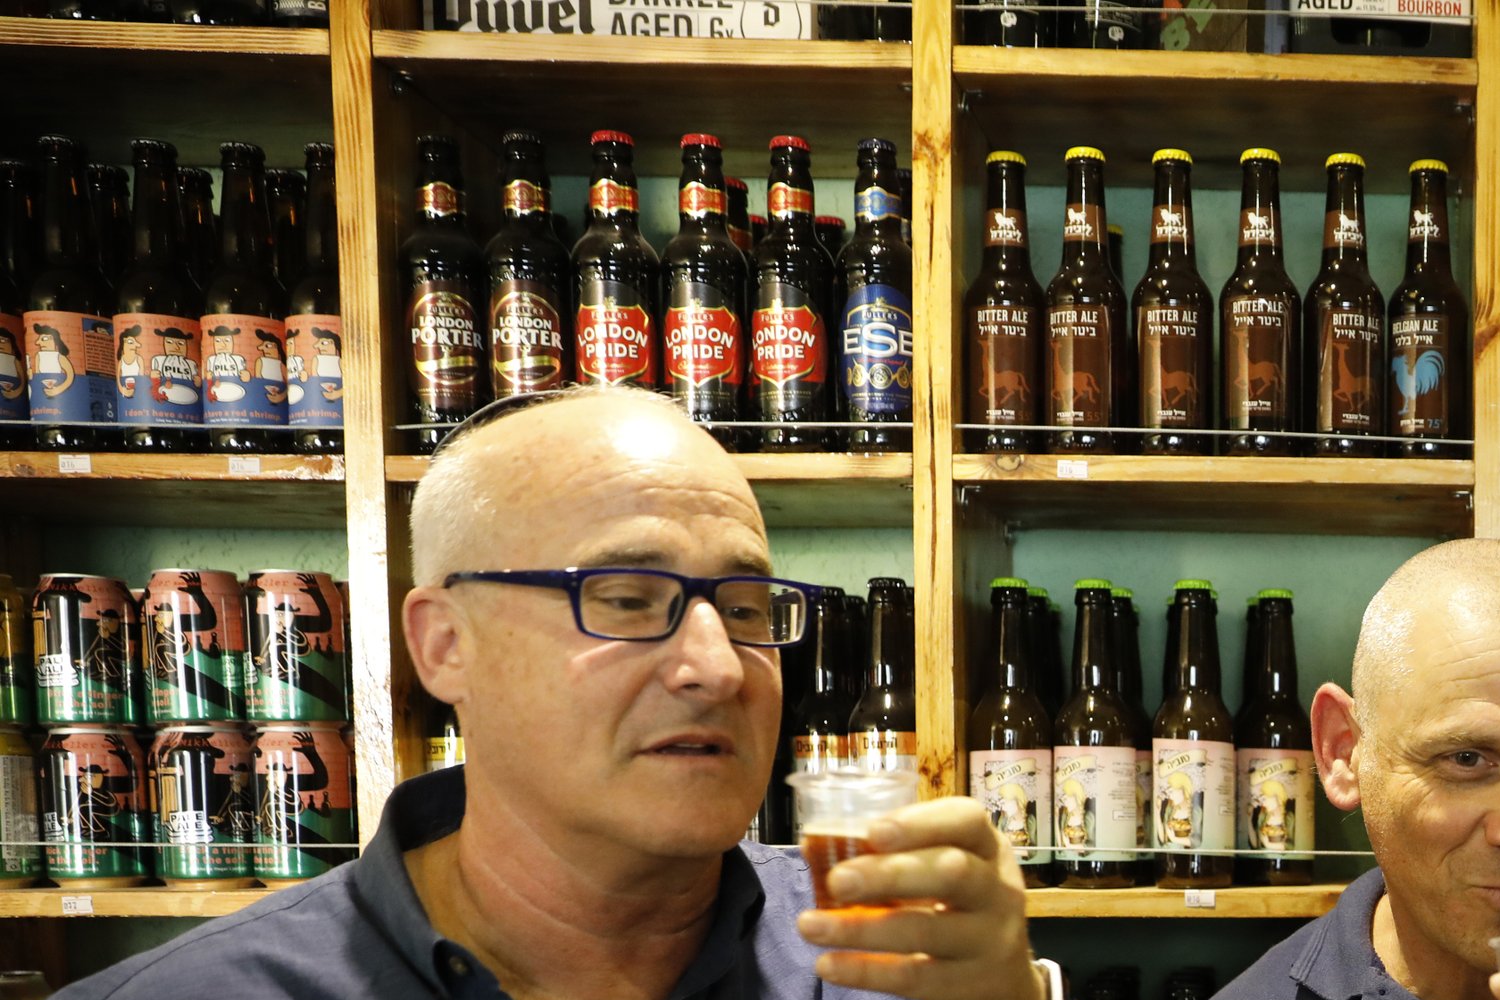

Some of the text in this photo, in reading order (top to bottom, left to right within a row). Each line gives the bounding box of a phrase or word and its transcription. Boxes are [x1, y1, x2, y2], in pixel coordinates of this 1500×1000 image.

[1397, 0, 1462, 16] BOURBON
[1233, 300, 1264, 314] BITTER
[420, 315, 474, 330] LONDON
[500, 315, 552, 330] LONDON
[978, 309, 1028, 323] BITTER ALE
[1082, 310, 1098, 323] ALE
[1147, 310, 1198, 323] BITTER ALE
[1333, 313, 1365, 327] BITTER
[1422, 319, 1438, 332] ALE
[411, 327, 484, 351] PORTER
[492, 327, 564, 351] PORTER
[578, 323, 648, 349] LONDON
[666, 324, 734, 350] LONDON
[753, 324, 815, 350] LONDON
[586, 343, 639, 360] PRIDE
[673, 343, 724, 360] PRIDE
[757, 343, 805, 360] PRIDE
[165, 365, 190, 375] PILS
[215, 364, 236, 372] PILS
